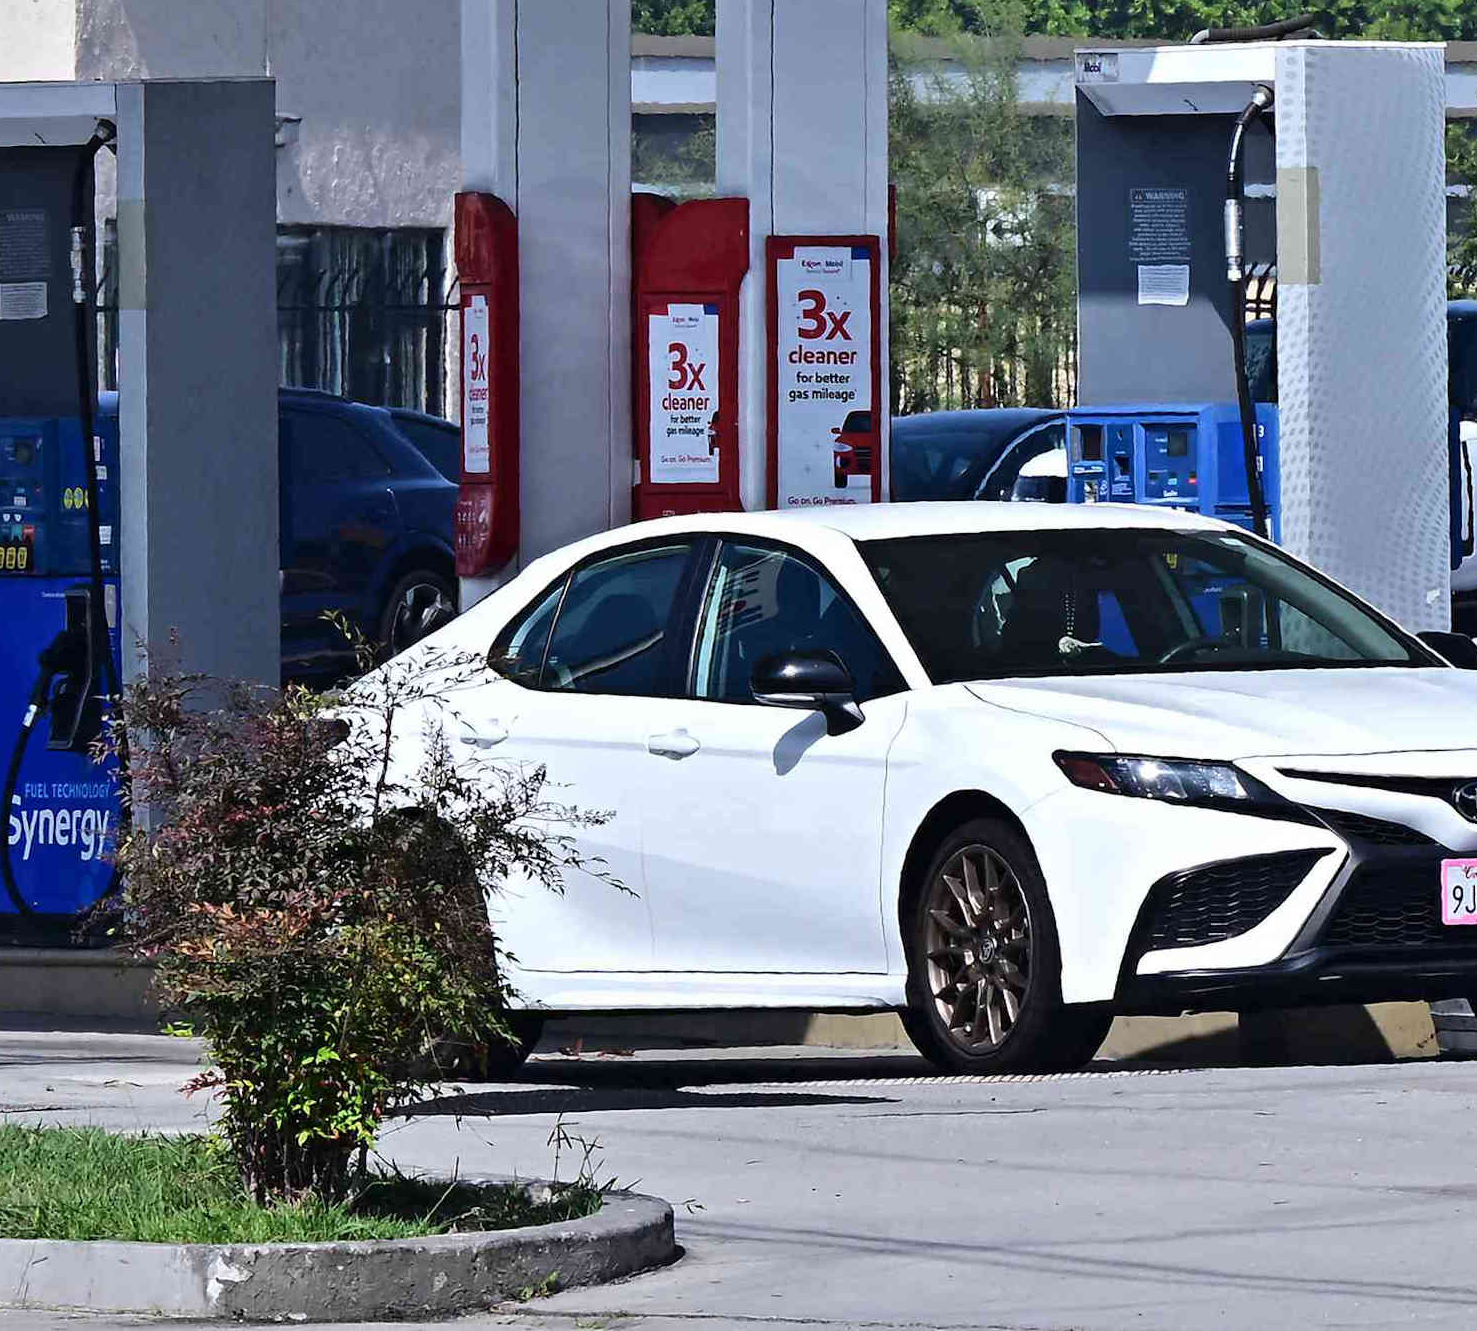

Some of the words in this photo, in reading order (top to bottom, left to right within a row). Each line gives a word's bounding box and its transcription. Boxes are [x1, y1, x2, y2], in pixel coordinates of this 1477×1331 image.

[797, 289, 853, 341] 3x
[470, 333, 486, 381] 3x
[788, 344, 858, 365] cleaner
[667, 342, 707, 391] 3x
[796, 371, 813, 384] for
[815, 371, 851, 384] better
[662, 393, 710, 411] cleaner
[788, 390, 809, 402] gas
[670, 414, 680, 424] for
[680, 414, 701, 424] better
[666, 426, 677, 437] gas
[24, 783, 49, 798] FUEL
[52, 782, 111, 798] TECHNOLOGY
[8, 794, 110, 861] Synergy
